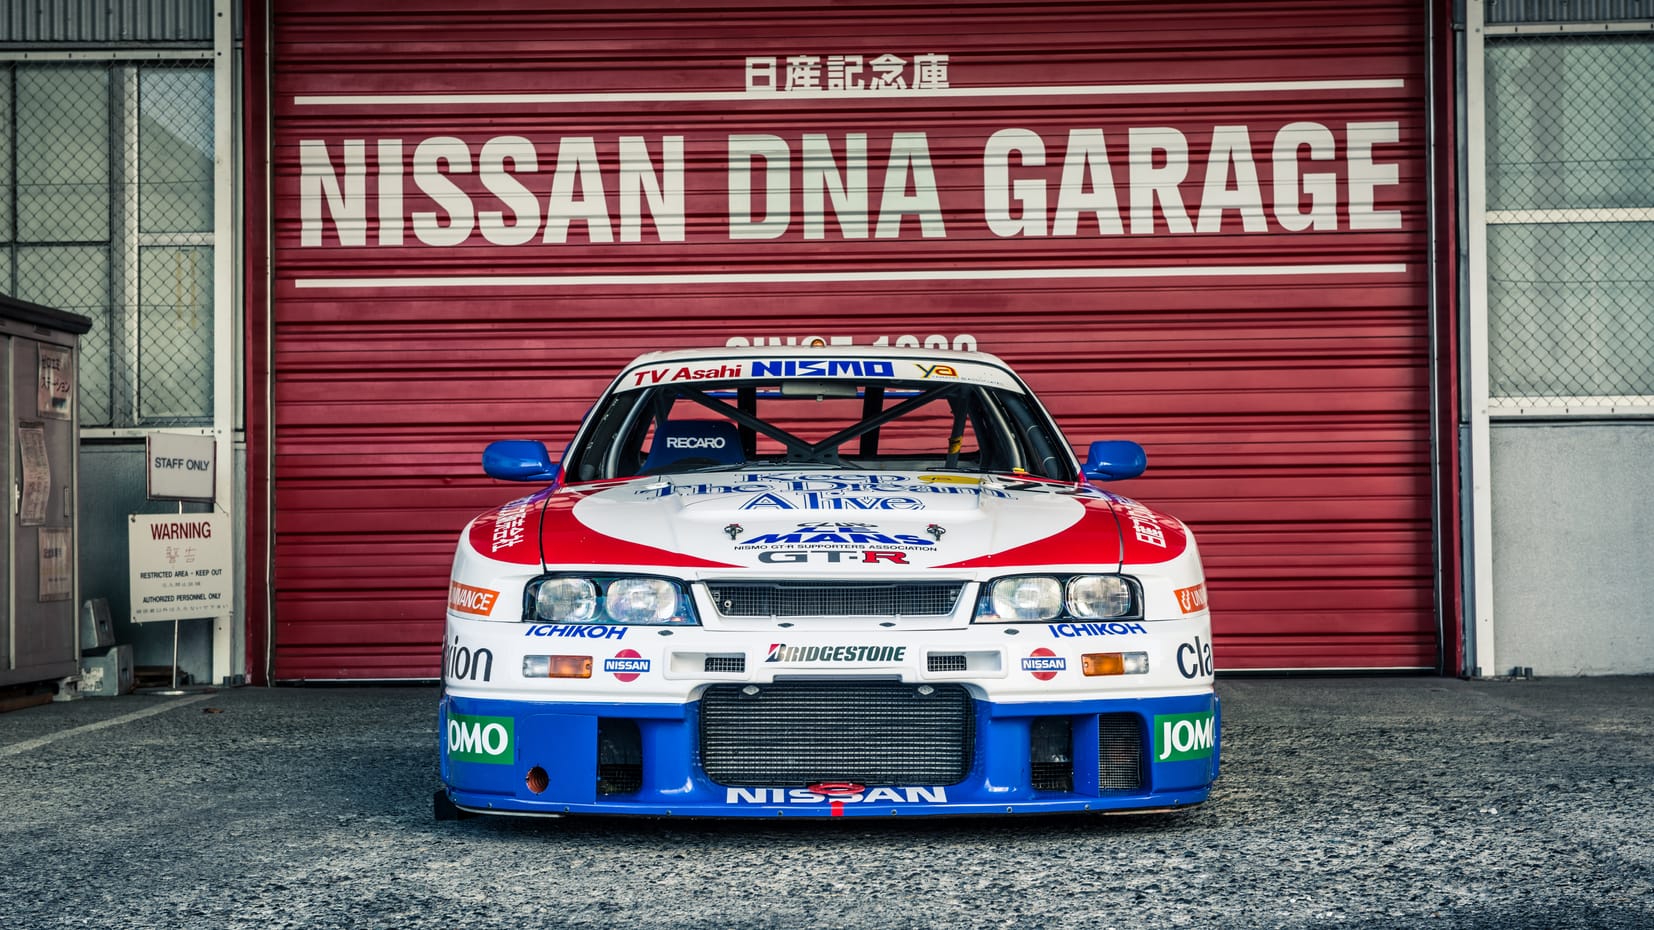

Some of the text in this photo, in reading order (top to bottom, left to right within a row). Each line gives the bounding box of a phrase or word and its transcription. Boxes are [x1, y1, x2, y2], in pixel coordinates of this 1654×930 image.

[745, 53, 950, 91] 日産記念庫
[300, 121, 1403, 247] NISSAN DNA GARAGE
[634, 364, 743, 386] TV Asahi
[751, 360, 895, 378] NISMO
[666, 436, 726, 449] RECARO
[154, 457, 210, 471] STAFF ONLY
[741, 472, 910, 484] Keep
[634, 482, 773, 500] The
[787, 480, 1014, 500] Dream
[738, 491, 925, 511] Alive
[150, 521, 212, 541] WARNING
[740, 533, 934, 546] MANS
[869, 544, 937, 552] ASSOCIATION
[758, 550, 910, 565] GT-R
[140, 570, 173, 579] RESTRICTED
[211, 568, 222, 576] OUT
[143, 592, 221, 603] AUTHORIZED PERSONNEL ONLY
[525, 625, 628, 640] ICHIKOH
[1048, 623, 1147, 638] ICHIKOH
[765, 643, 906, 663] BRIDGESTONE
[605, 659, 650, 672] NISSAN
[1022, 658, 1065, 671] NISSAN
[447, 718, 508, 756] OMO
